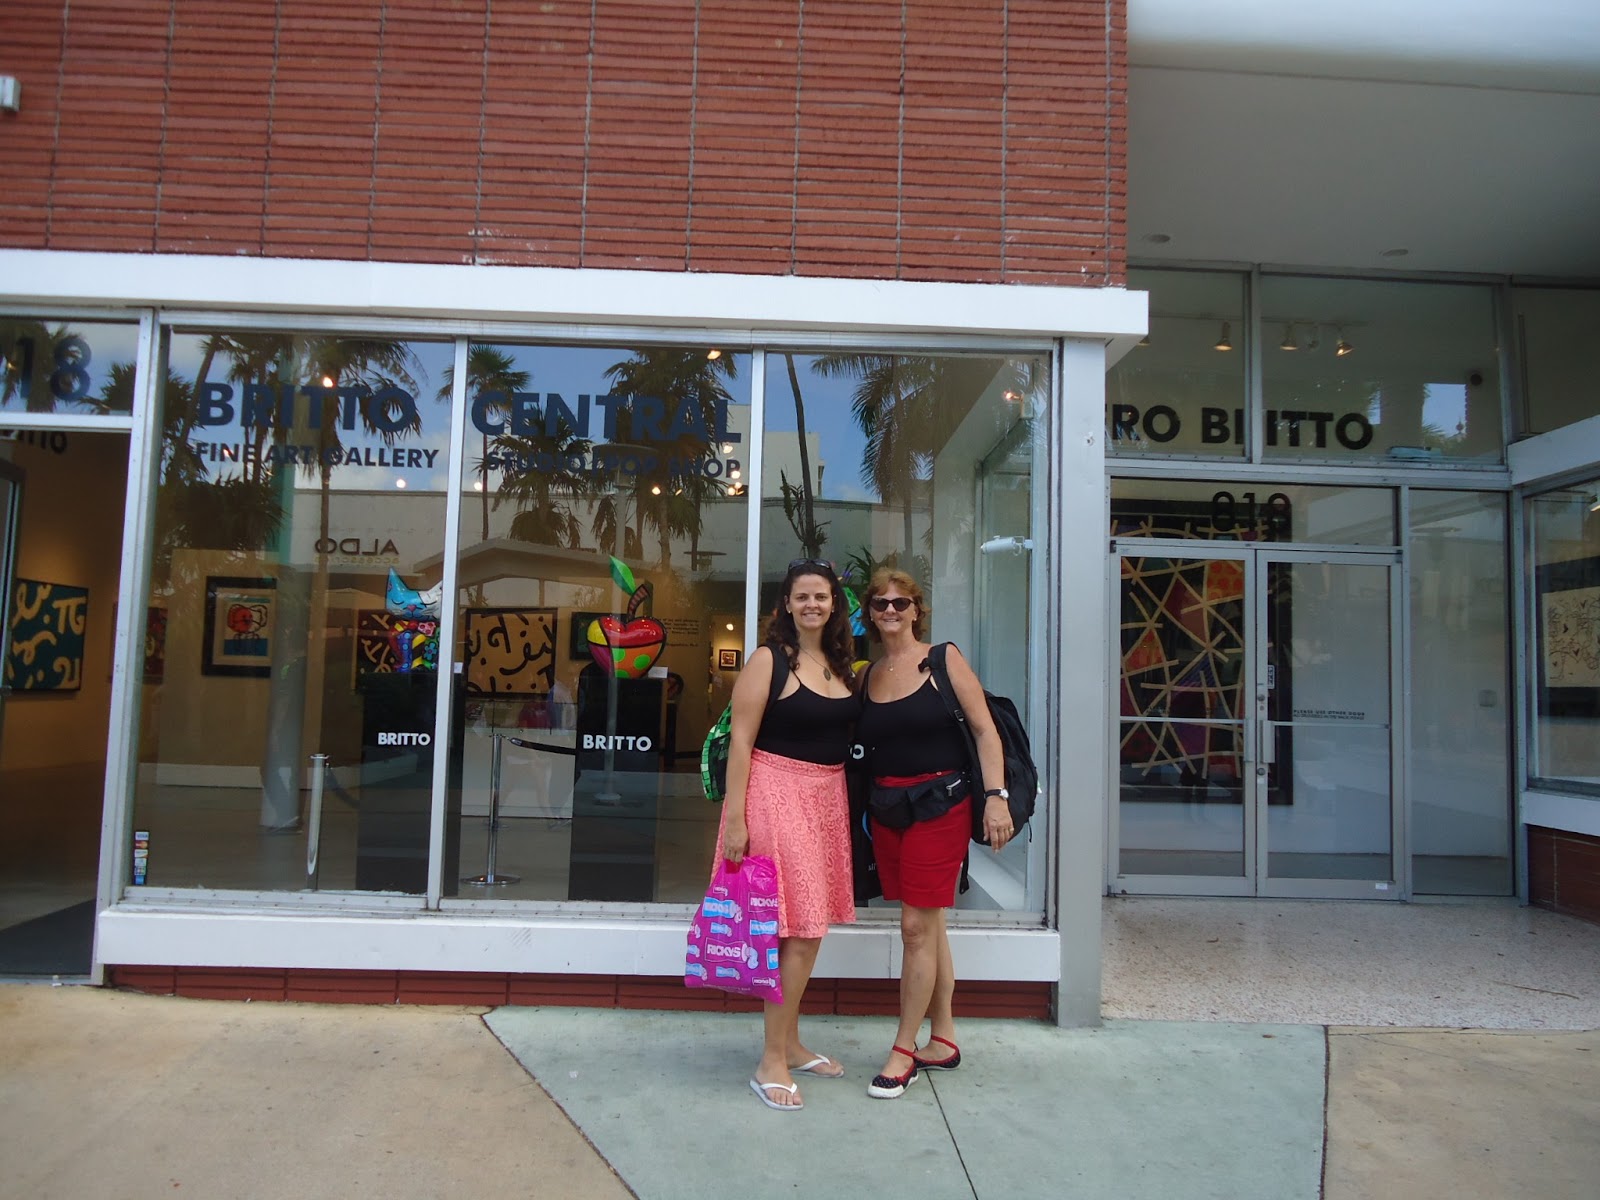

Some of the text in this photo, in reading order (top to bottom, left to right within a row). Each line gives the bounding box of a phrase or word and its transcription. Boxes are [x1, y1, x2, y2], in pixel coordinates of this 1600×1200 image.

[201, 382, 741, 443] BRITTO CENTRAL
[1105, 404, 1180, 442] RO
[197, 442, 439, 469] FINE ART GALLERY
[486, 451, 585, 472] STUDIO
[670, 457, 740, 478] SHOP
[378, 732, 652, 752] BRITTO BRITTO
